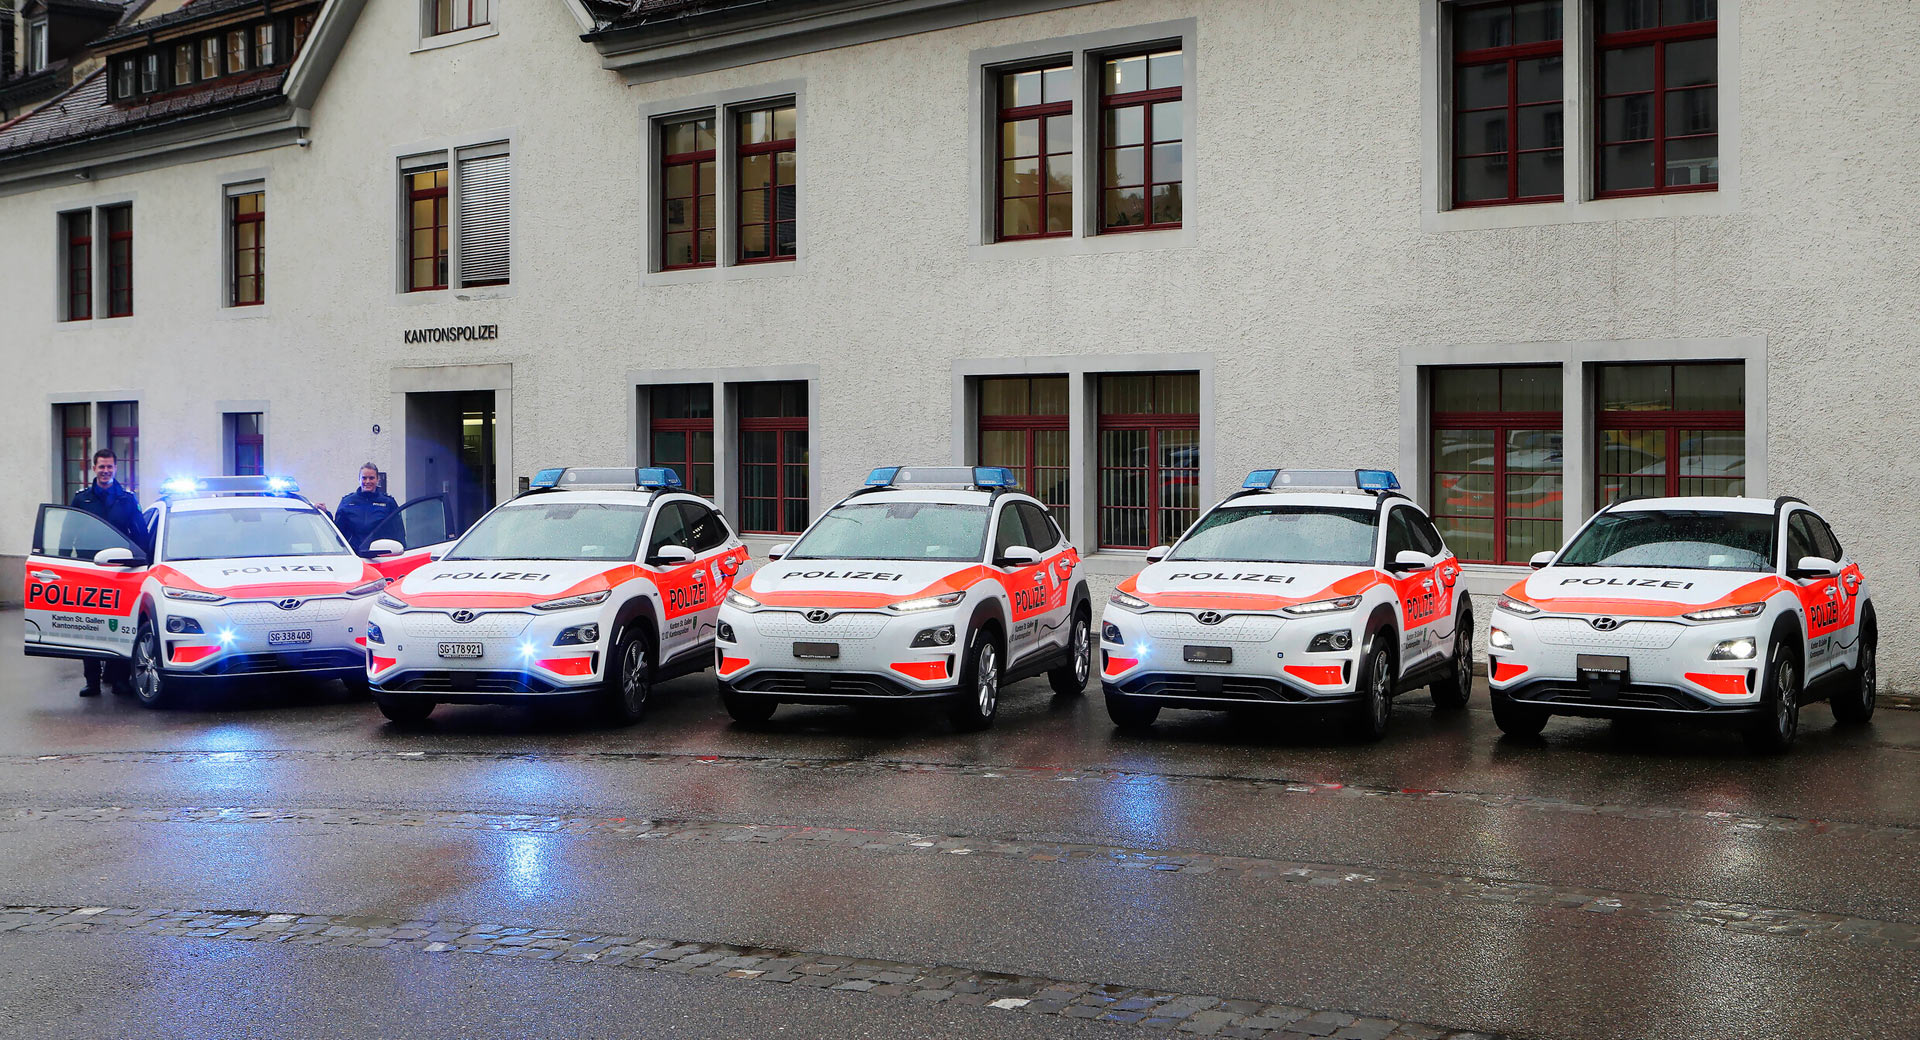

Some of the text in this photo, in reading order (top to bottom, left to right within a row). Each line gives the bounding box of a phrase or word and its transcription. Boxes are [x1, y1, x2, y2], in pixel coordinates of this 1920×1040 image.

[404, 324, 498, 344] KANTONSPOLIZEI
[222, 565, 334, 576] POLIZEI
[782, 571, 903, 581] POLIZEI
[431, 572, 551, 581] POLIZEI
[1169, 573, 1296, 584] POLIZEI
[1560, 578, 1694, 590] POLIZEI
[29, 583, 120, 609] POLIZEI
[669, 582, 707, 611] POLIZEI
[1015, 584, 1047, 614] POLIZEI
[52, 614, 105, 625] Kanton St. Gallen
[52, 621, 100, 632] Kantonspolizei
[121, 625, 130, 634] 52
